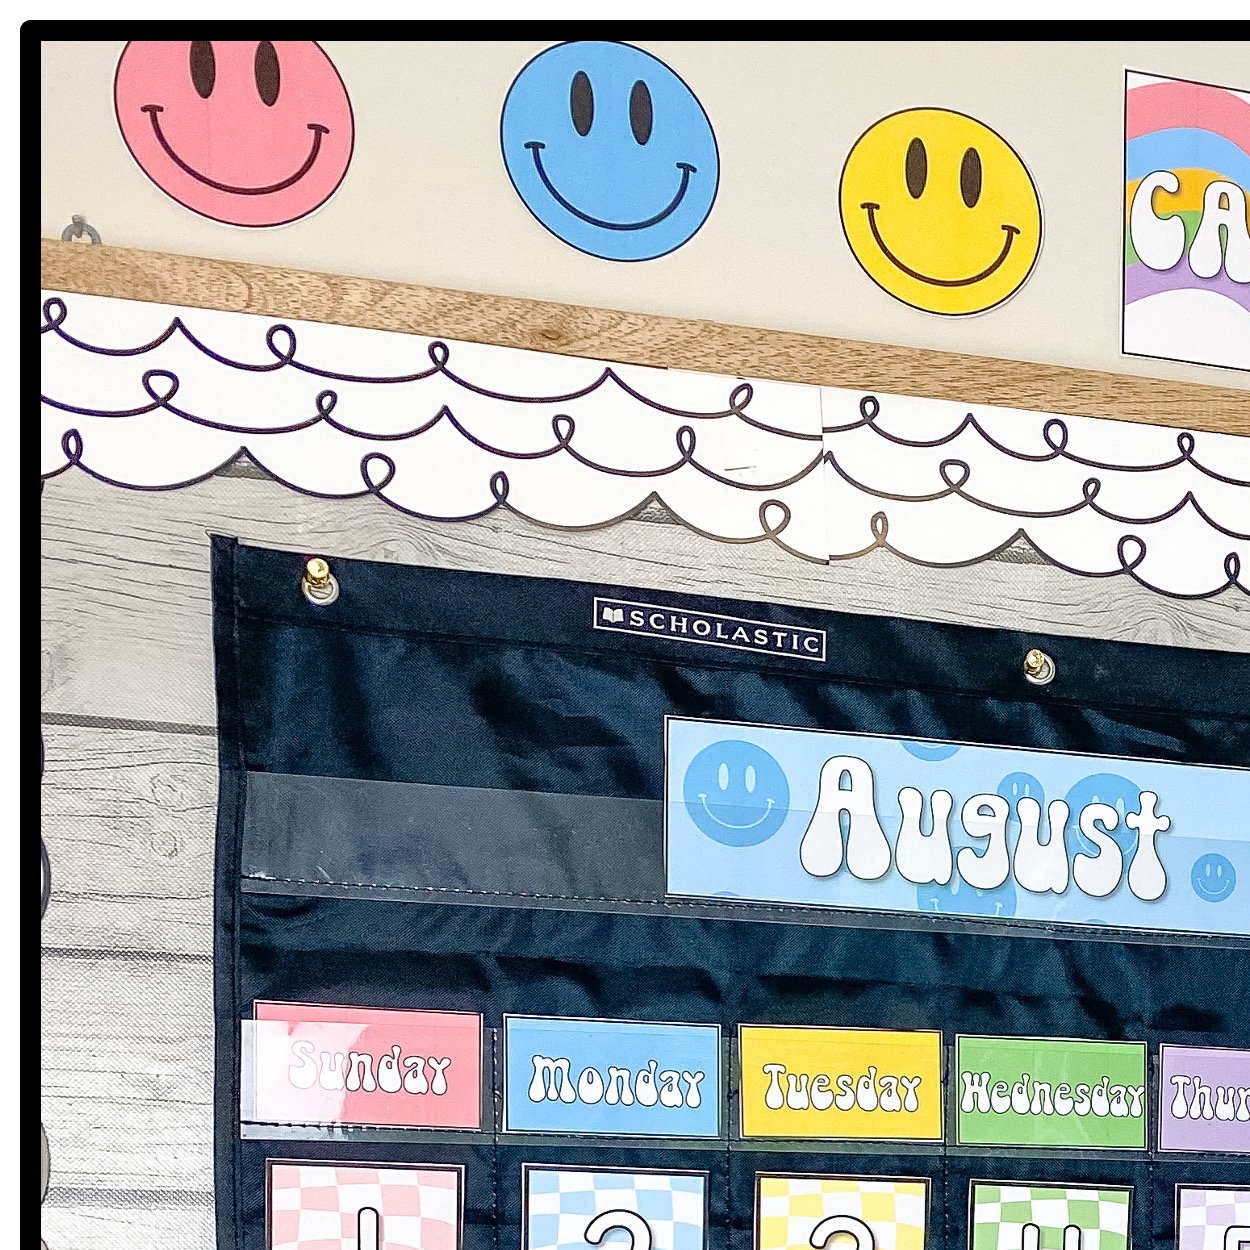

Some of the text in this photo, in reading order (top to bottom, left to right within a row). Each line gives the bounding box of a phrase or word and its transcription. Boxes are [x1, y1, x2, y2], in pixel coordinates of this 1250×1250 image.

[629, 609, 821, 655] SCHOLASTIC
[798, 756, 1172, 902] August
[288, 1039, 452, 1096] Sunday
[528, 1052, 704, 1108] Monday
[762, 1061, 922, 1113] Tuesday
[960, 1072, 1146, 1117] Wednesday
